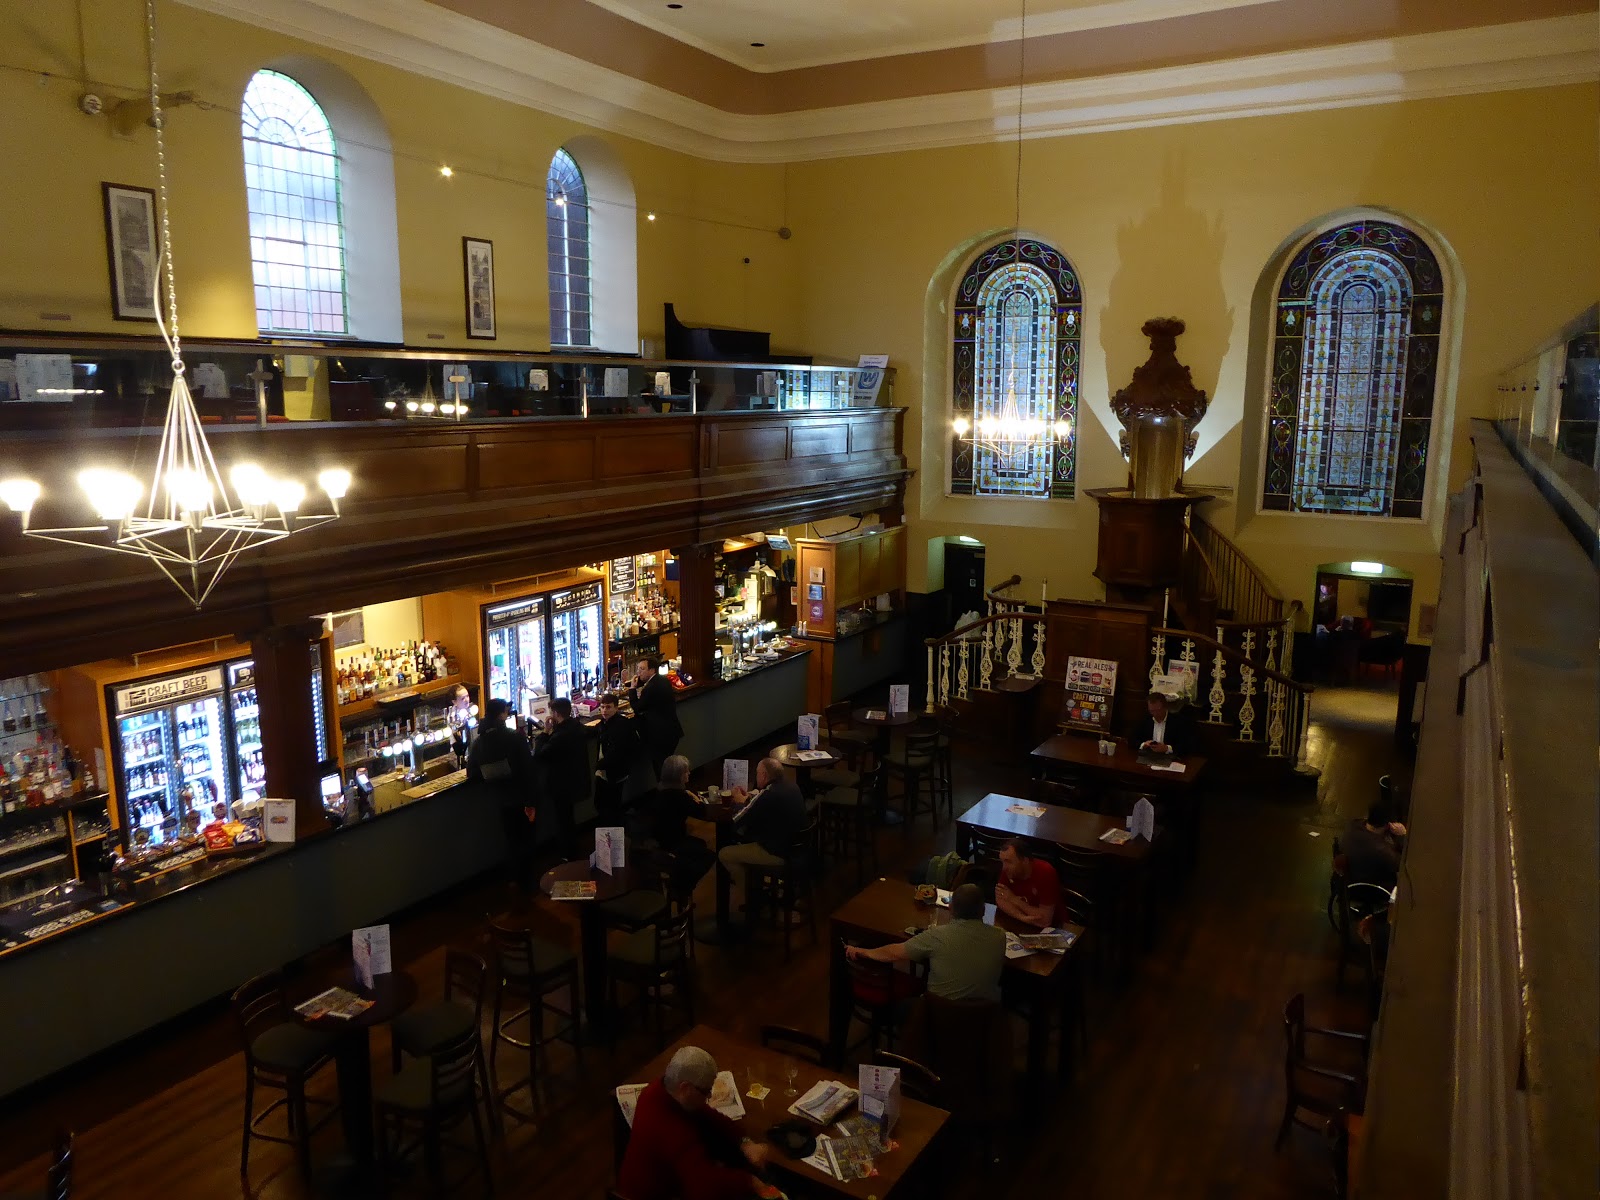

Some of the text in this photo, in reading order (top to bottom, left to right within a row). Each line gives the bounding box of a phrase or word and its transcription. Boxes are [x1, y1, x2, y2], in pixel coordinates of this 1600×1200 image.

[1077, 660, 1108, 671] REAL ALES
[147, 681, 179, 696] CRAFT
[183, 676, 207, 688] BEER
[1073, 692, 1105, 703] CRAFT BEERS
